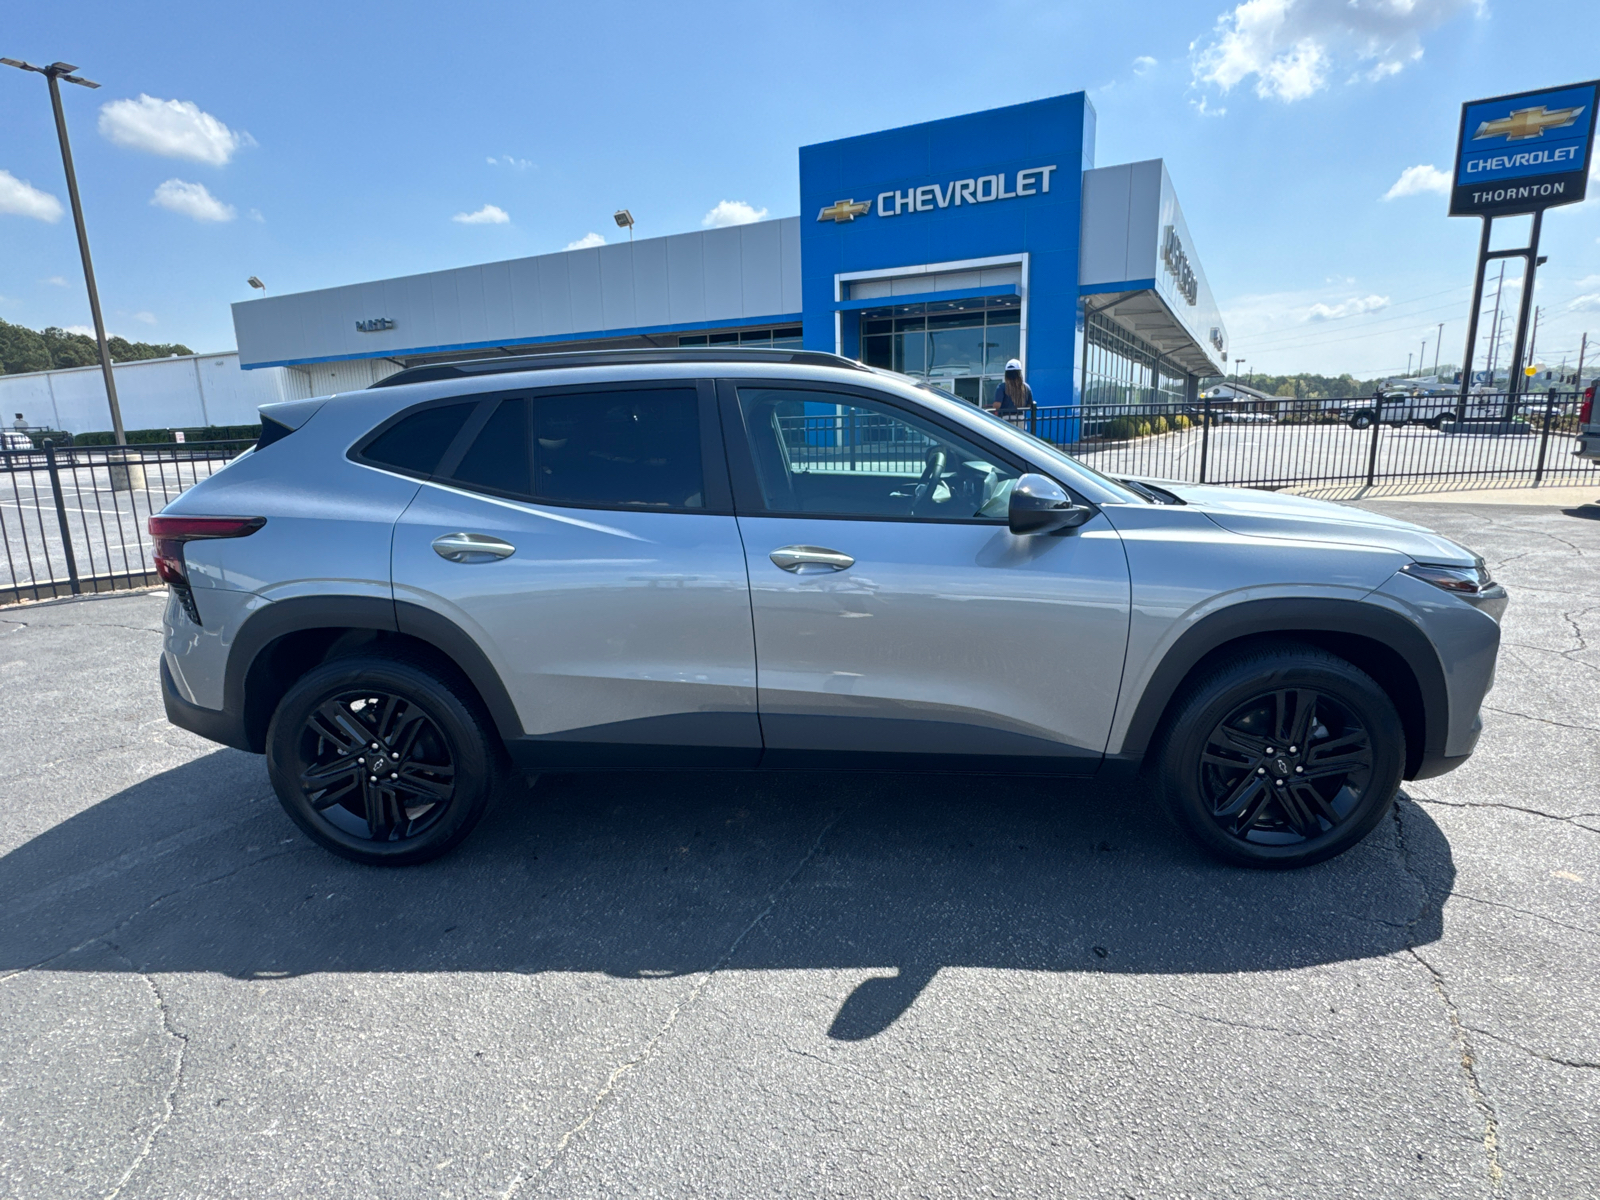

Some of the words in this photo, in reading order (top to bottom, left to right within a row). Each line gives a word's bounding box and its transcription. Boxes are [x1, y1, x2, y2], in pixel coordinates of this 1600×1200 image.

[1467, 146, 1579, 173] CHEVROLET
[877, 165, 1057, 217] CHEVROLET
[1472, 182, 1565, 203] THORNTON
